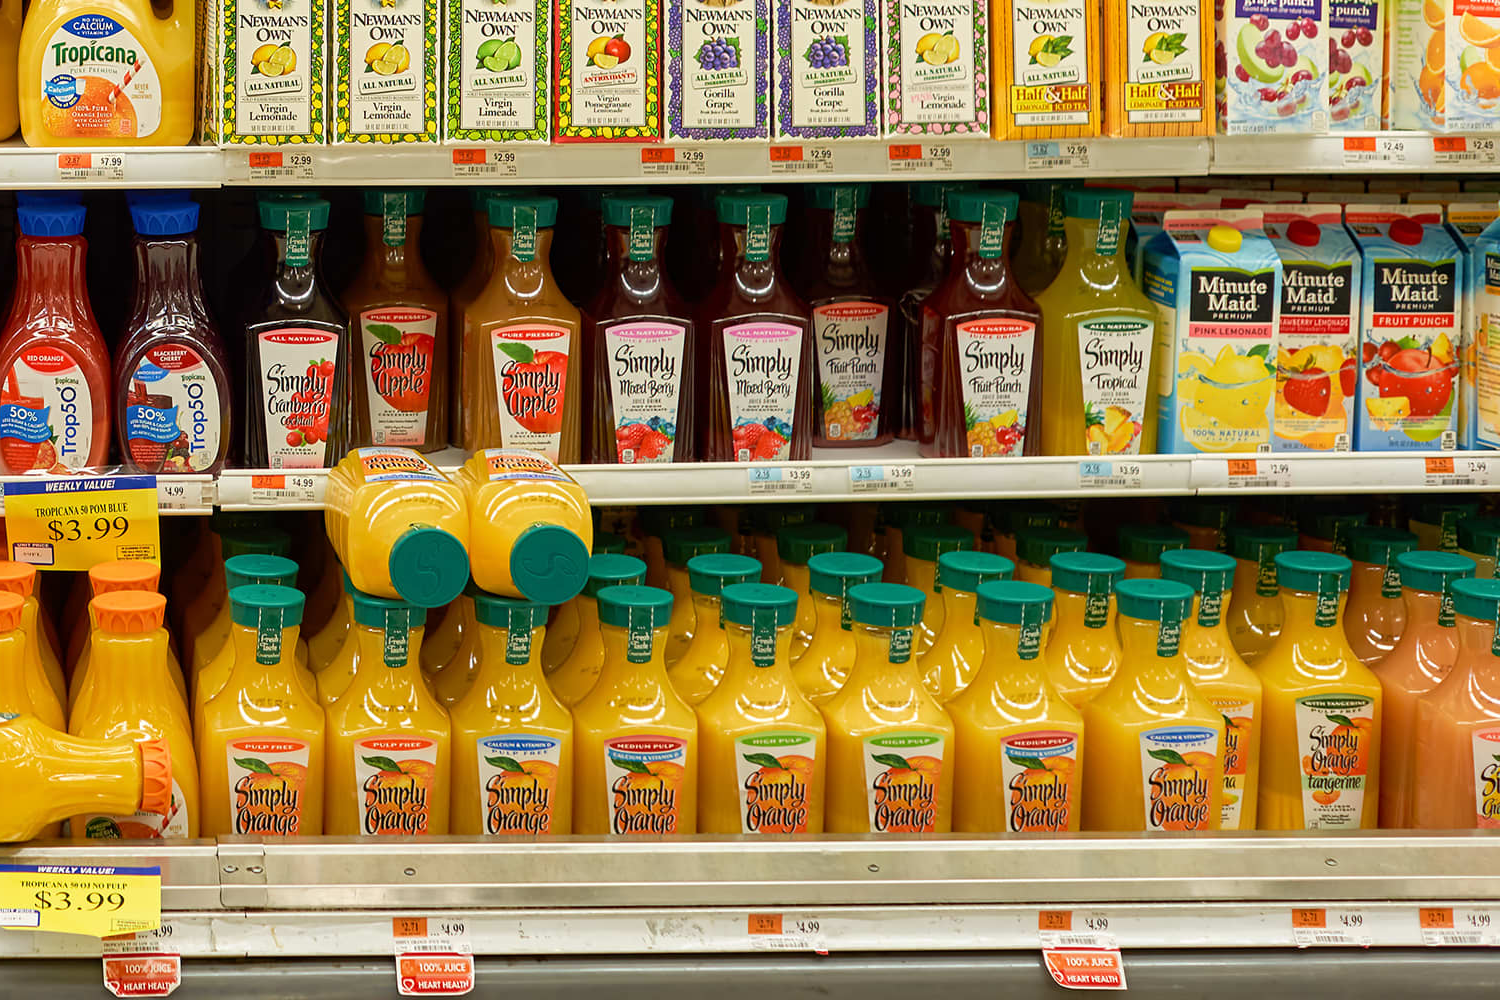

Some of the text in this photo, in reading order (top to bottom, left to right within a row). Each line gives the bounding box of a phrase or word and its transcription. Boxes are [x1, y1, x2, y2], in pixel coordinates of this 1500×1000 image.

[240, 14, 308, 29] NEWMAN'S
[685, 8, 753, 23] NEWMAN'S
[256, 27, 292, 42] OWN
[702, 22, 737, 36] OWN
[52, 42, 137, 67] Tropicana
[583, 72, 636, 83] ANTIOXIDANTS
[248, 80, 300, 92] ALL NATURAL
[703, 89, 735, 99] Gorilla
[259, 104, 288, 114] Virgin
[705, 99, 733, 110] Grape
[249, 112, 297, 122] Lemonade
[100, 157, 122, 168] $7.99
[290, 155, 312, 165] $2.99
[1198, 275, 1267, 295] Minute
[1208, 293, 1258, 311] Maid
[1213, 312, 1253, 320] PREMIUM
[1378, 316, 1448, 326] FRUIT PUNCH
[1194, 326, 1268, 337] PINK LEMONADE
[154, 350, 187, 358] BLACKBERRY
[614, 344, 677, 378] Simply
[267, 364, 328, 396] Simply
[500, 360, 561, 393] Simply
[620, 379, 675, 398] Mixed Berry
[968, 377, 1022, 393] Fruit Punch
[267, 398, 326, 416] Cranberry
[508, 391, 557, 419] Apple
[280, 415, 313, 426] Cocktail
[45, 480, 115, 492] WEEKLY VALUE!
[36, 503, 128, 517] TROPICANA 50 POM BLUE
[48, 516, 129, 542] $3.99
[1308, 774, 1361, 793] tangerine
[234, 777, 299, 812] Simply
[235, 808, 300, 836] Orange
[1086, 917, 1108, 930] $4.99
[420, 963, 466, 972] 100% JUICE
[418, 981, 440, 989] HEART
